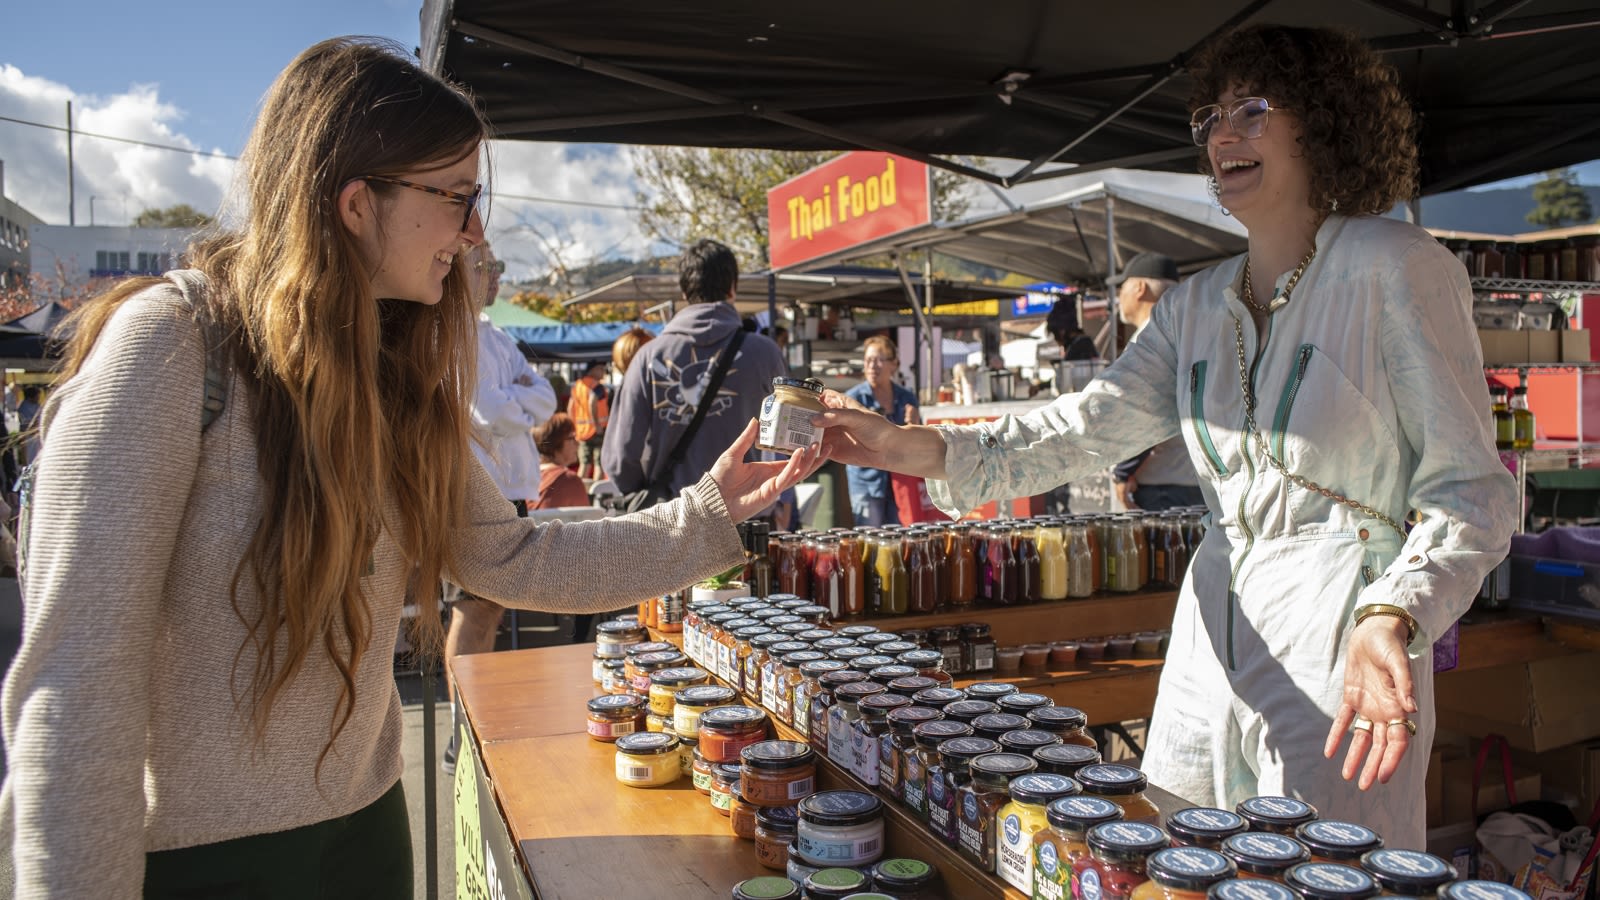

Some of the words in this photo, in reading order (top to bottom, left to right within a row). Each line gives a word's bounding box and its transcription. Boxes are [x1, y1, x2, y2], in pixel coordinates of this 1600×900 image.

[787, 184, 832, 241] Thai
[836, 158, 897, 223] Food
[1000, 840, 1027, 867] HORSERADISH
[1001, 853, 1013, 868] LEMON
[1012, 861, 1025, 875] CREAM
